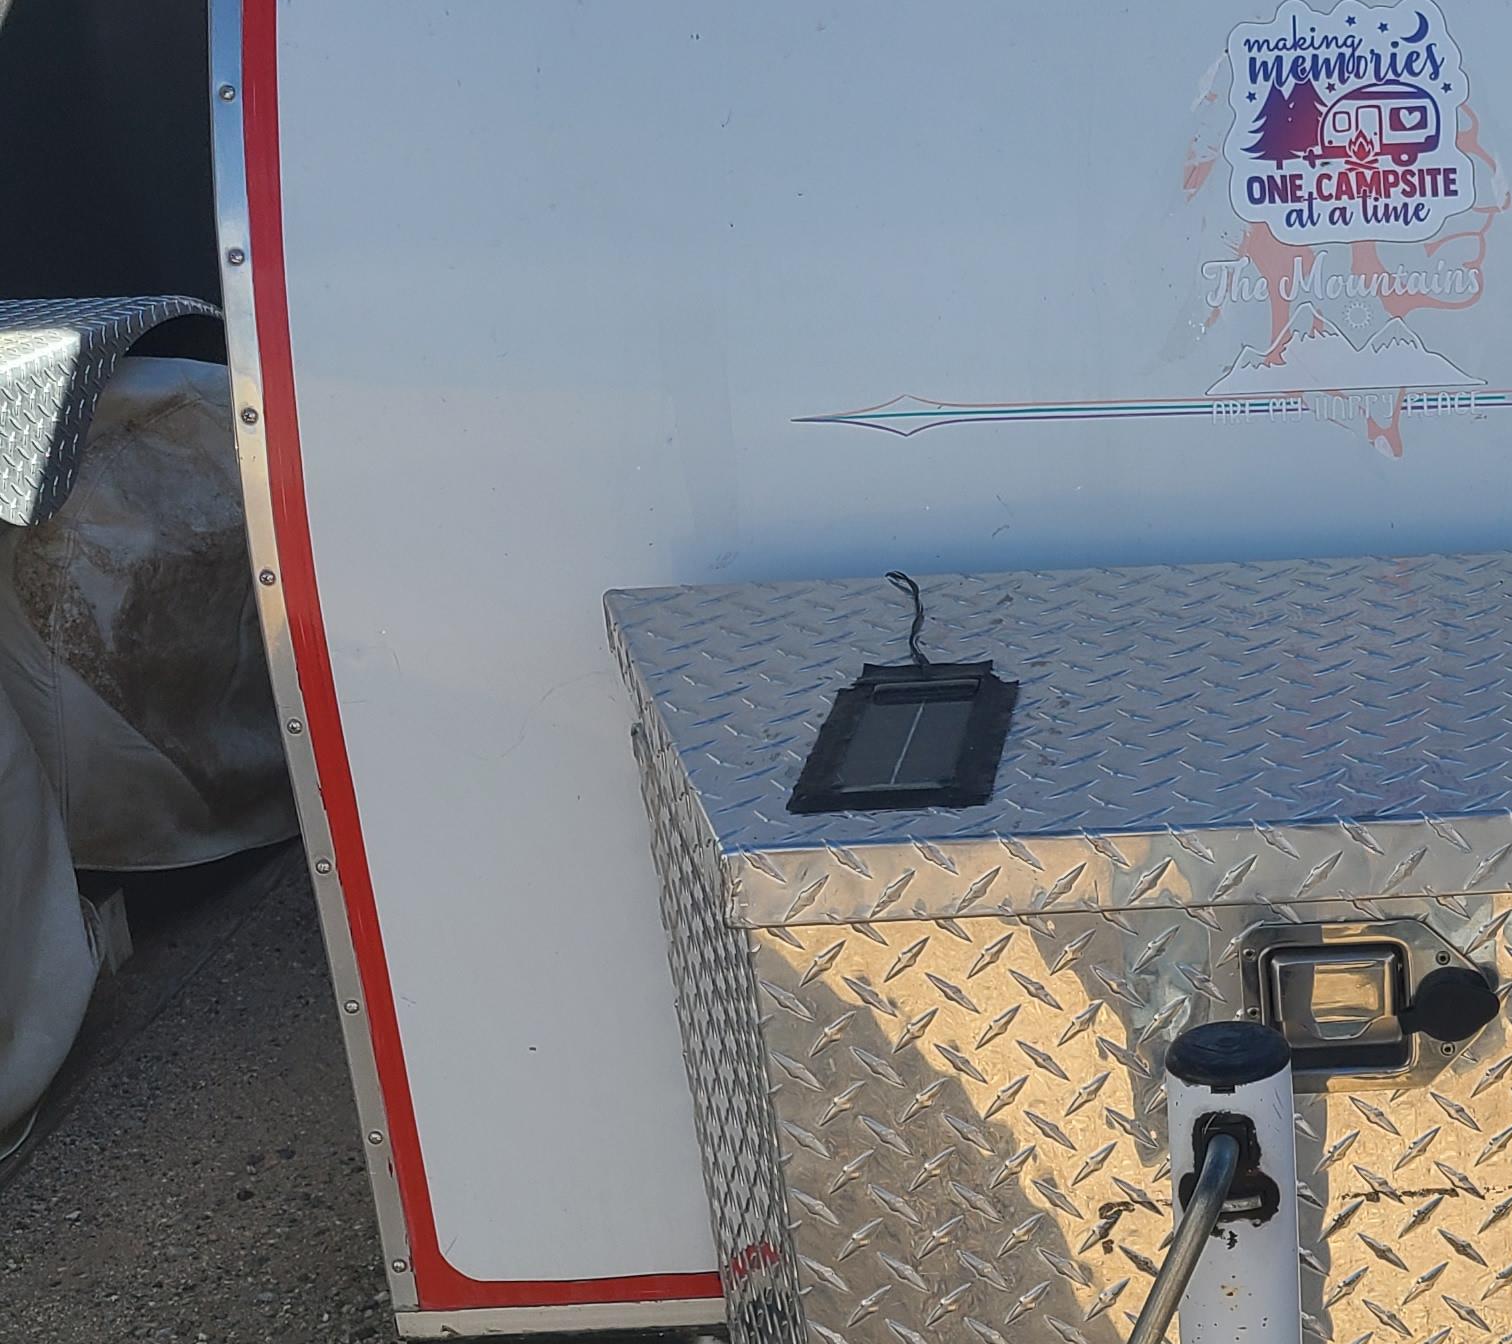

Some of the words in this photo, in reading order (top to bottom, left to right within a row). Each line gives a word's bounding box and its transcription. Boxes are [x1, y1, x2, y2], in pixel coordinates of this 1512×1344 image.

[1244, 15, 1363, 76] making
[1249, 43, 1445, 88] memories
[1246, 173, 1304, 205] ONE
[1316, 167, 1459, 201] CAMPSITE
[1285, 191, 1321, 228] at
[1328, 206, 1354, 226] a
[1357, 189, 1431, 226] time
[1202, 256, 1270, 308] The
[1279, 250, 1481, 302] Mountains
[1211, 399, 1252, 425] ARE
[1269, 396, 1302, 423] MY
[1314, 391, 1394, 421] HAPPY
[1405, 389, 1485, 418] PLACE
